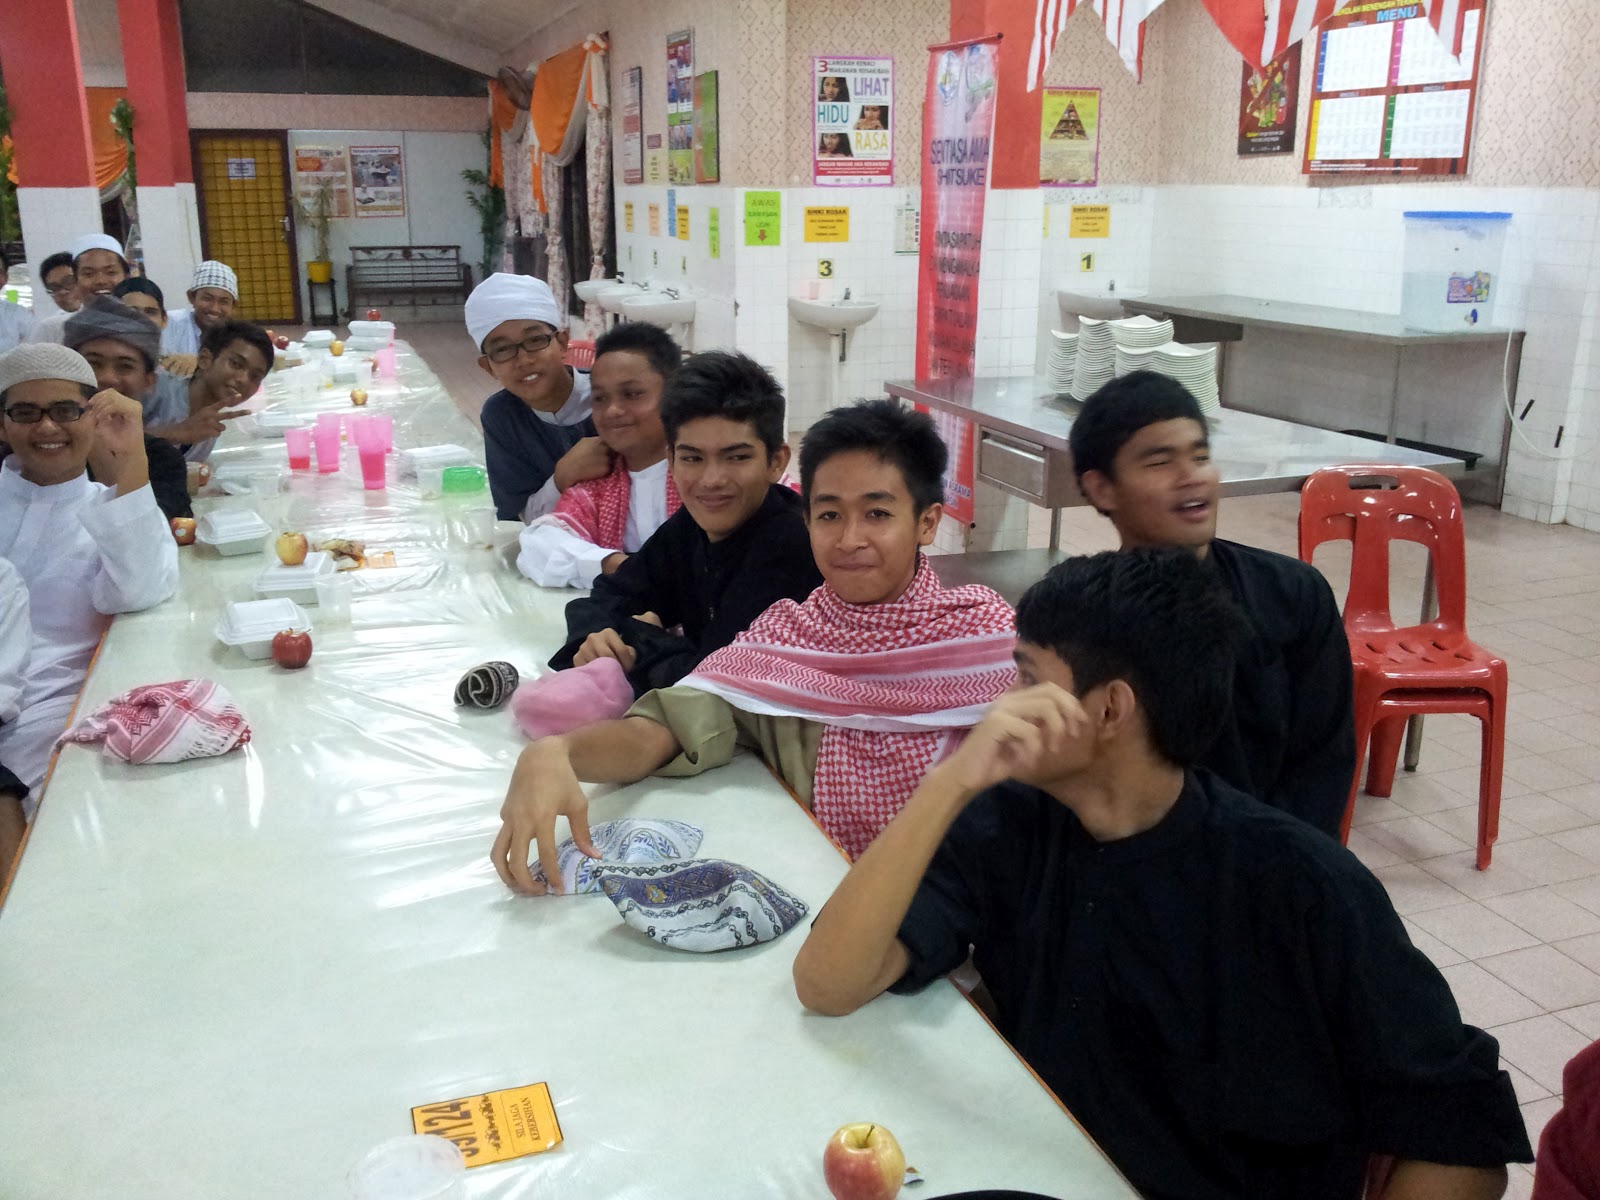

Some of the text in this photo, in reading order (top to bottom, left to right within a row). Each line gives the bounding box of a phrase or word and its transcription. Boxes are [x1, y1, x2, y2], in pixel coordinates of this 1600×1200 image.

[1376, 6, 1417, 23] MENU
[818, 60, 828, 73] 3
[853, 77, 889, 97] LIHAT
[817, 104, 849, 124] HIDU
[855, 132, 888, 151] RASA
[937, 167, 985, 186] SHITSUKE
[819, 260, 833, 277] 3
[1082, 253, 1092, 270] 1
[509, 1103, 526, 1138] SILA JAGA
[520, 1097, 541, 1142] KEBERSIHAN
